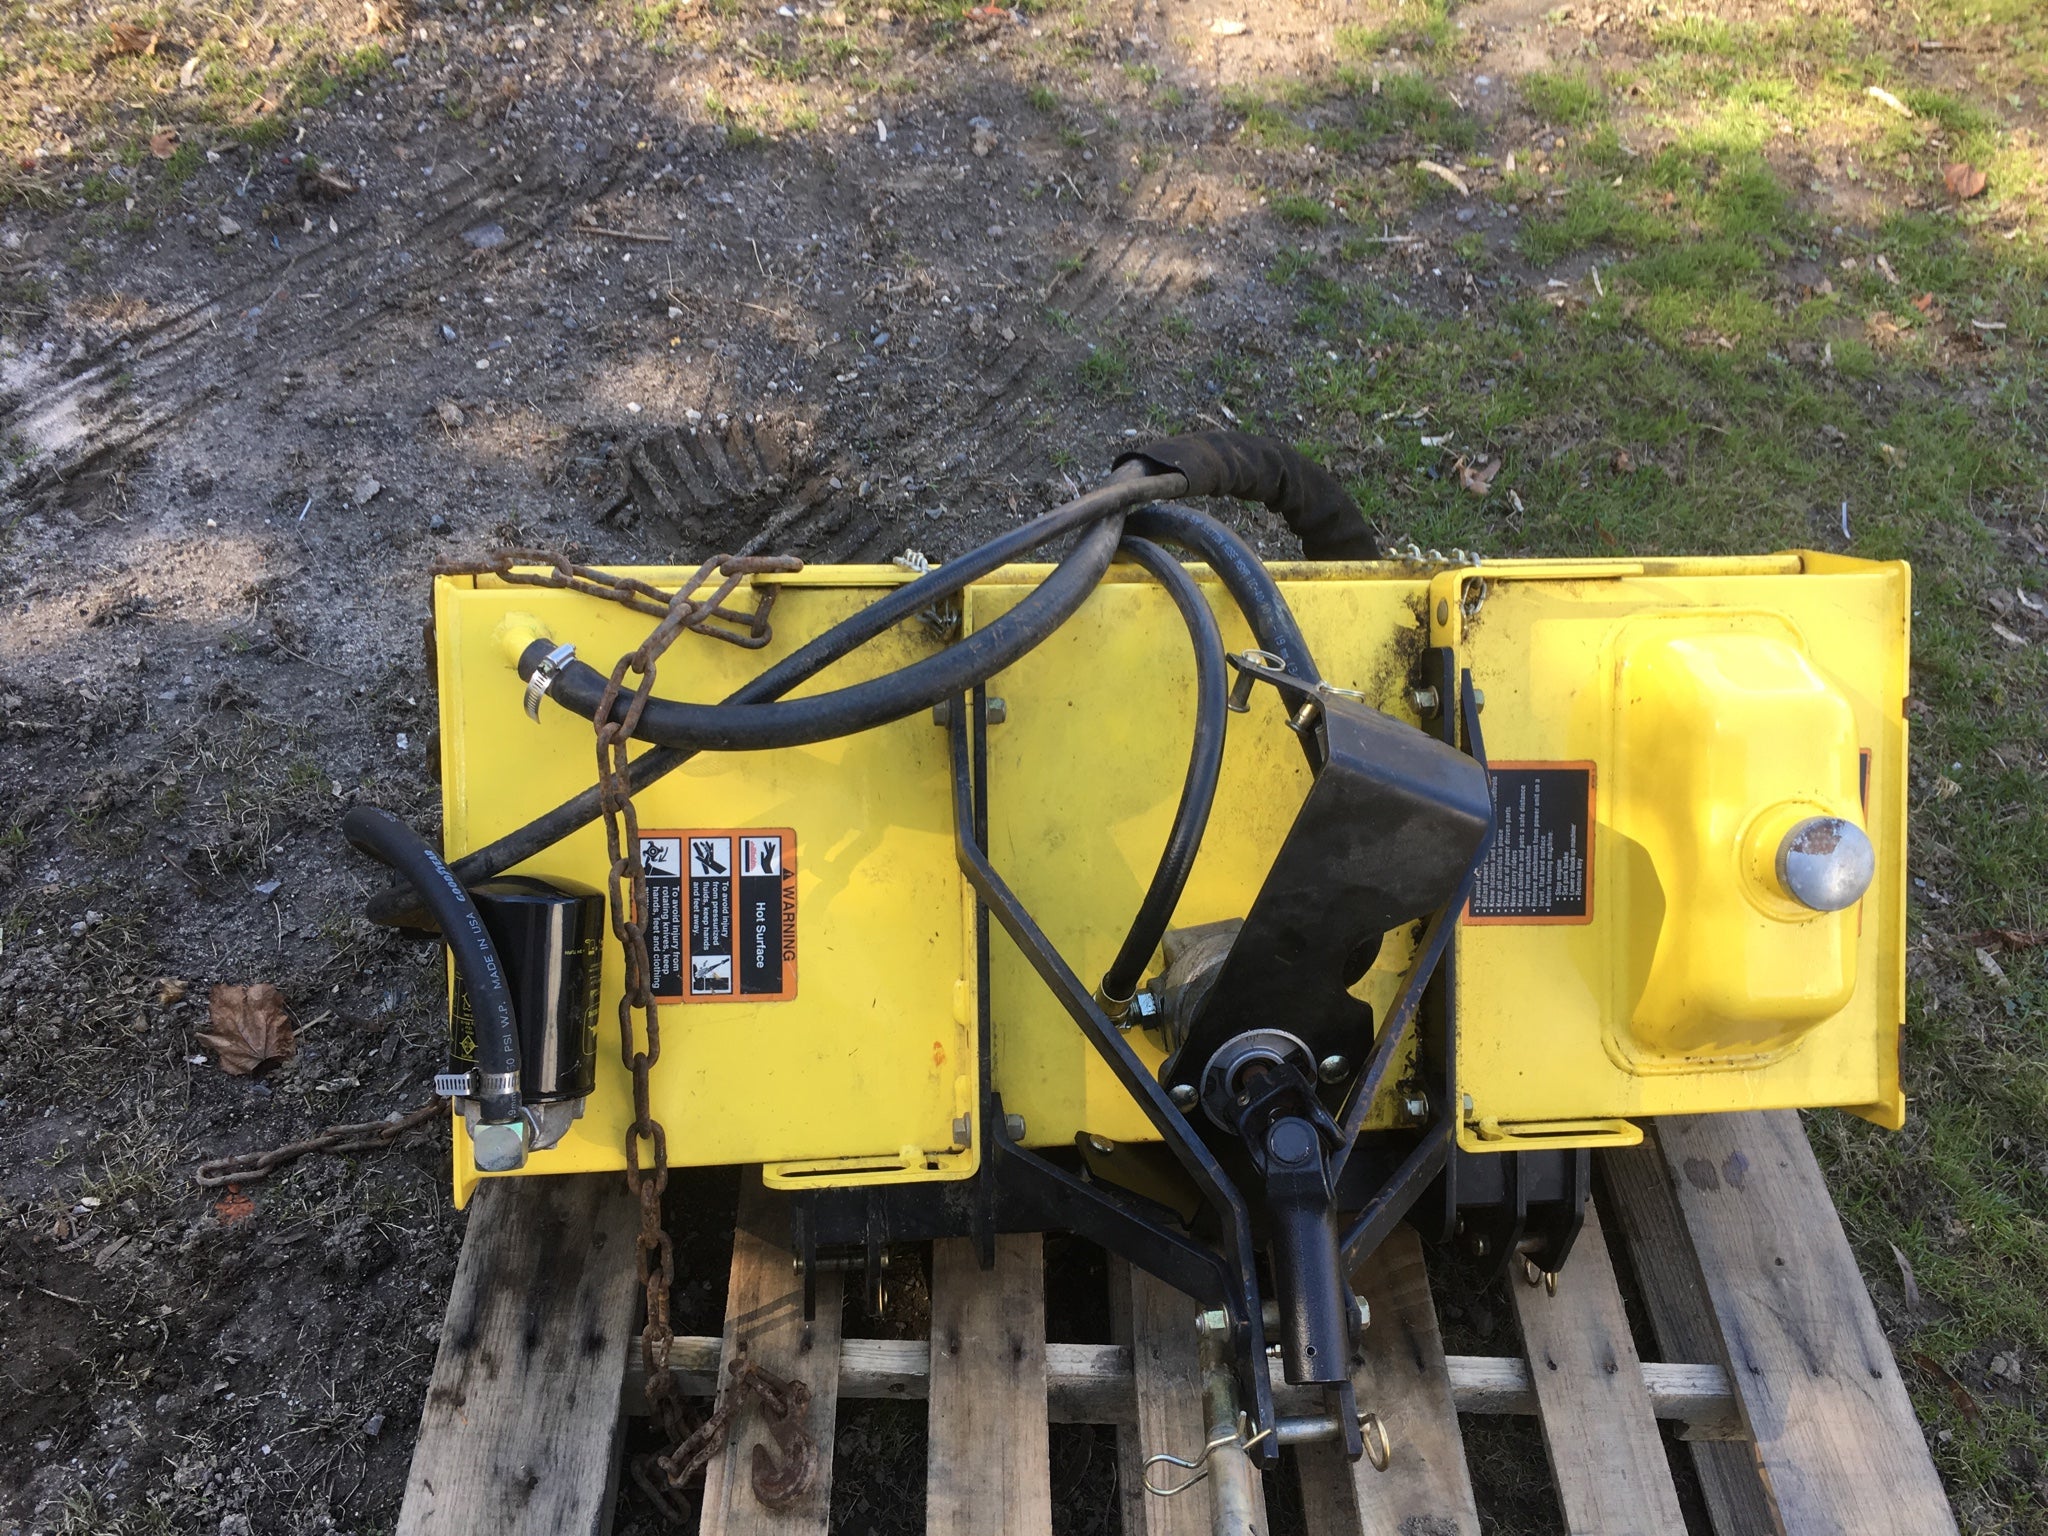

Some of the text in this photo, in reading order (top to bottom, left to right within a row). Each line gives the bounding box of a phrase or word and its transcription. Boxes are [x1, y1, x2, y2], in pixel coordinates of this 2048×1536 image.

[1535, 784, 1540, 792] on
[1497, 847, 1503, 855] in
[1571, 848, 1576, 856] up
[424, 849, 466, 902] GOODYEAR
[722, 881, 729, 892] To
[652, 886, 660, 915] hands,
[672, 886, 680, 897] To
[672, 899, 680, 923] avoid
[1474, 899, 1481, 907] To
[466, 912, 482, 934] USA
[653, 917, 661, 934] feet
[702, 908, 710, 925] keep
[711, 901, 720, 946] pressurized
[721, 915, 729, 937] injury
[783, 886, 795, 961] WARNING
[661, 886, 670, 975] rotating knives, keep
[671, 925, 680, 949] injury
[756, 902, 766, 968] Hot Surface
[477, 938, 489, 950] IN
[484, 954, 502, 989] MADE
[652, 953, 661, 988] clothing
[498, 1001, 510, 1028] W.P.
[504, 1034, 513, 1052] PSI
